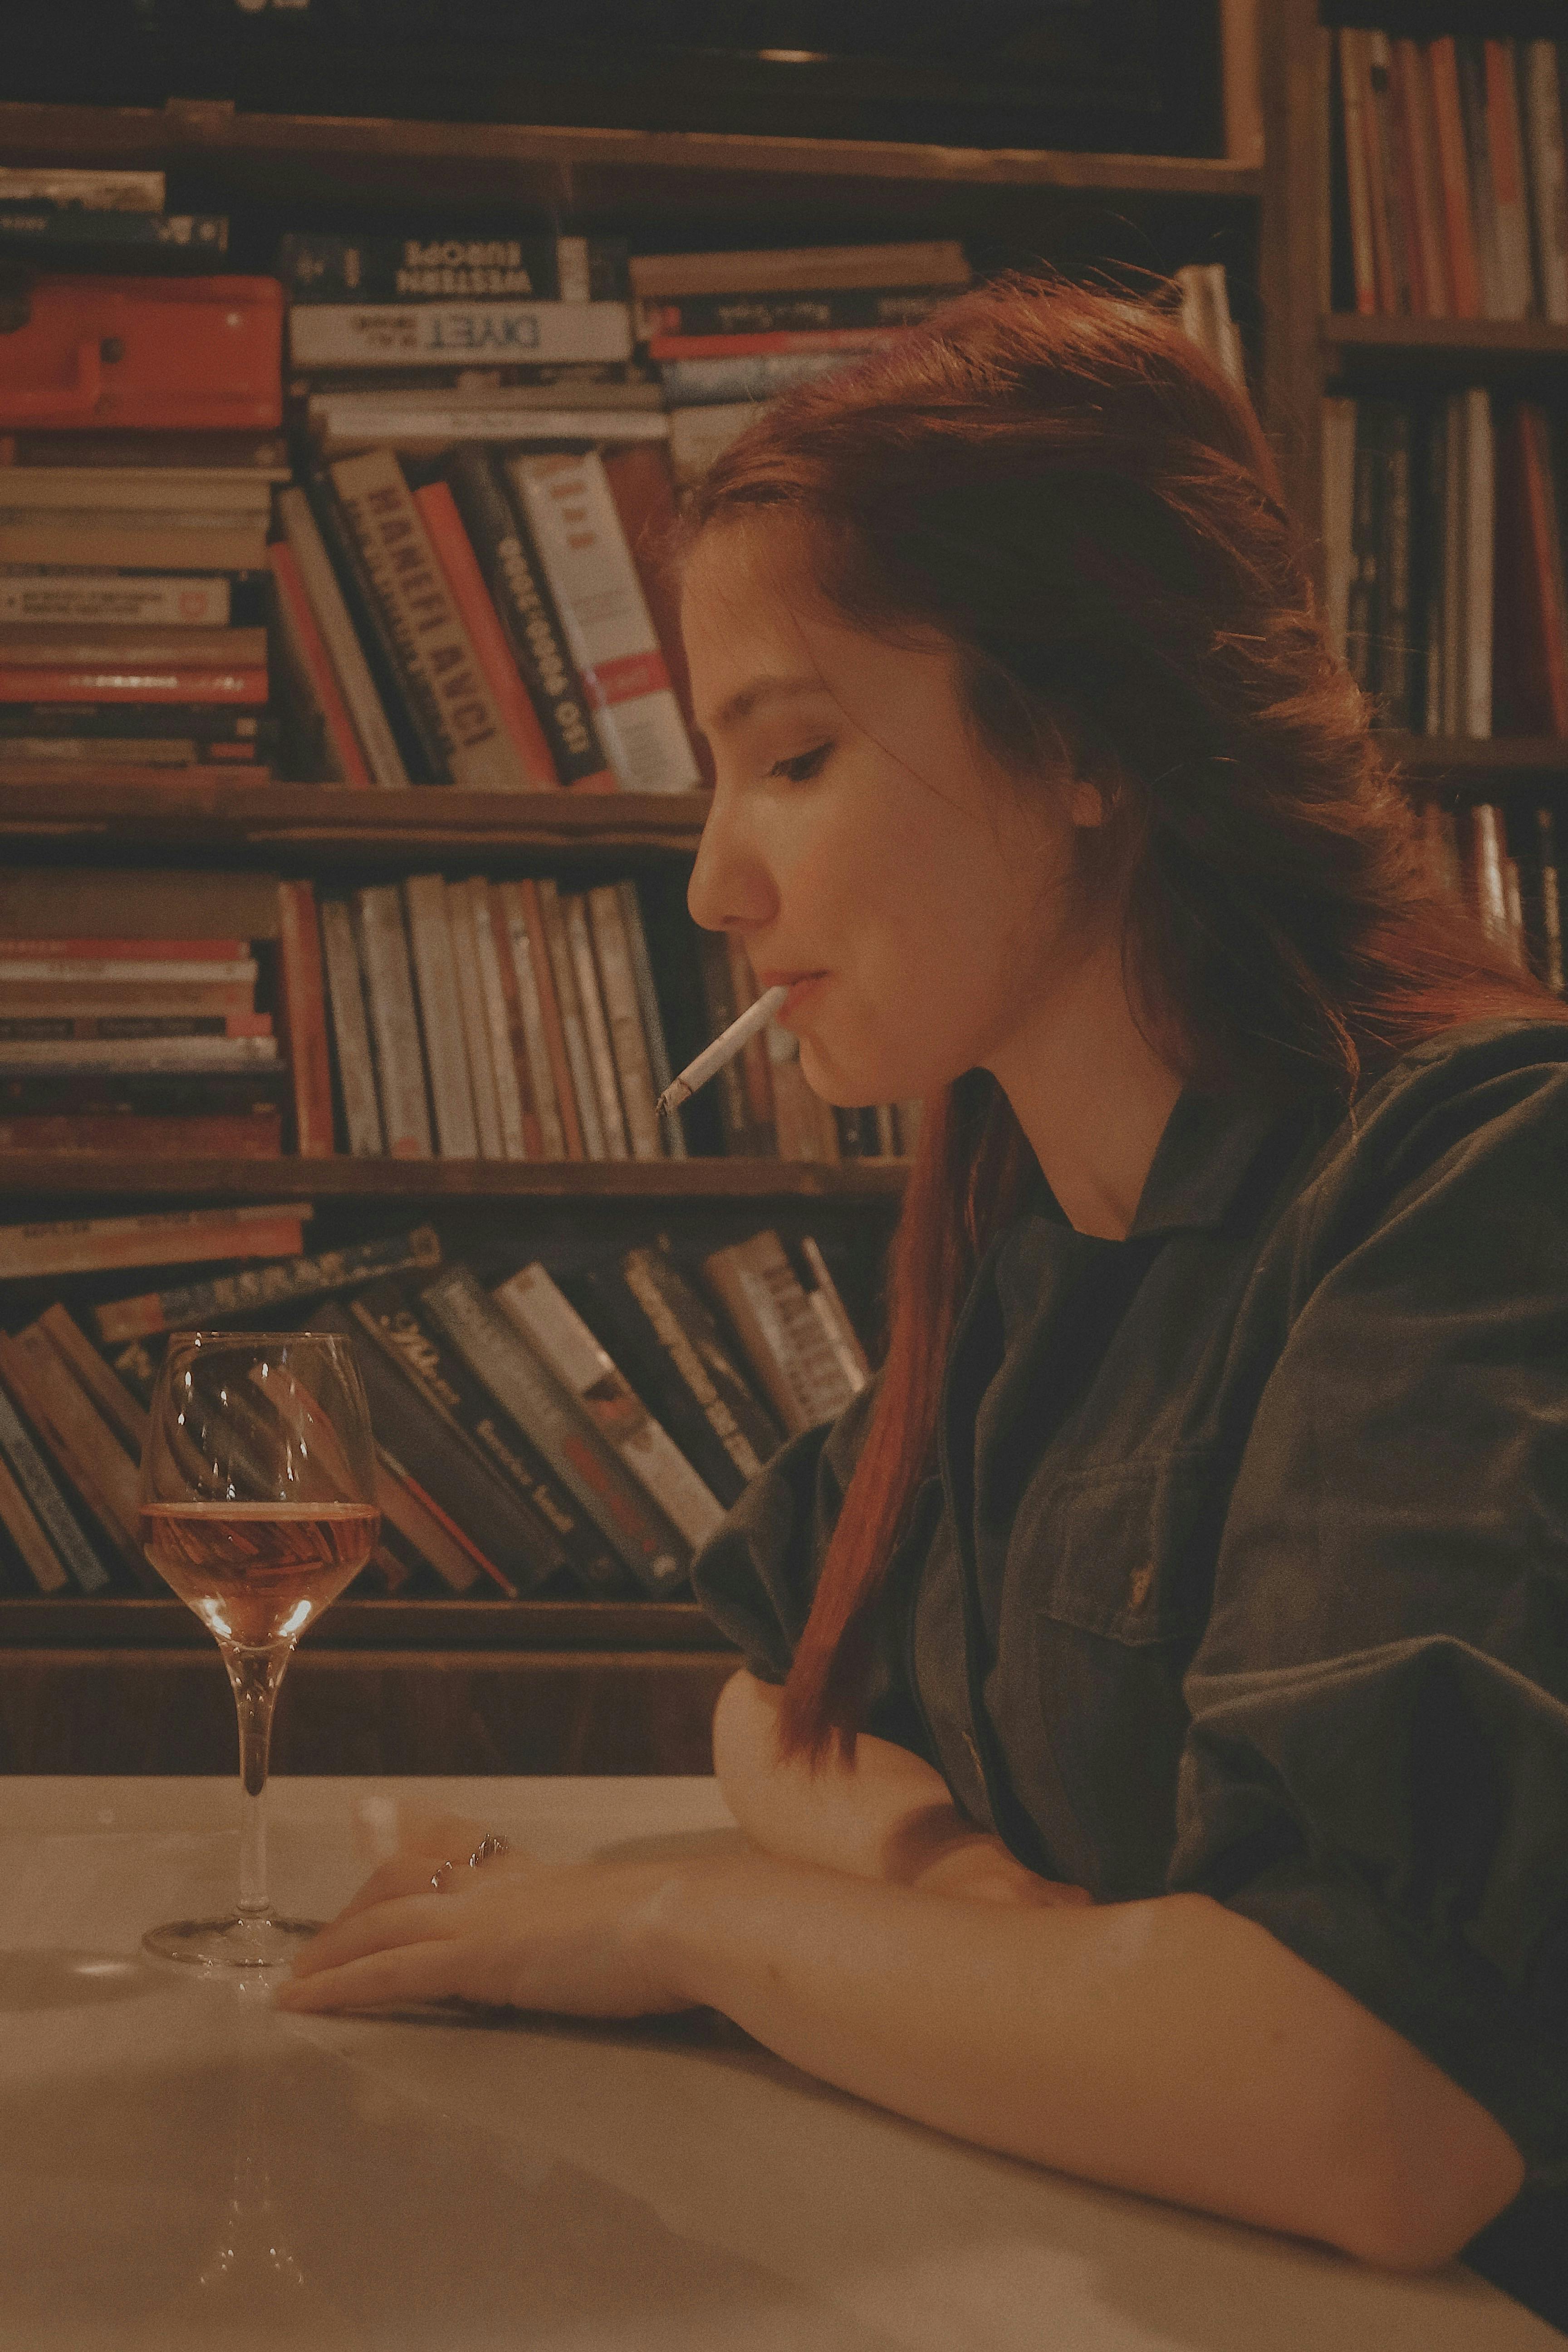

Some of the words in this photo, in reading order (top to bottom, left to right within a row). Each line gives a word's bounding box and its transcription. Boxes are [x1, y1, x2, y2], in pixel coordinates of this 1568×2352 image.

[405, 241, 520, 265] EUROPE
[396, 270, 532, 294] WESTERN
[551, 698, 593, 755] ISO
